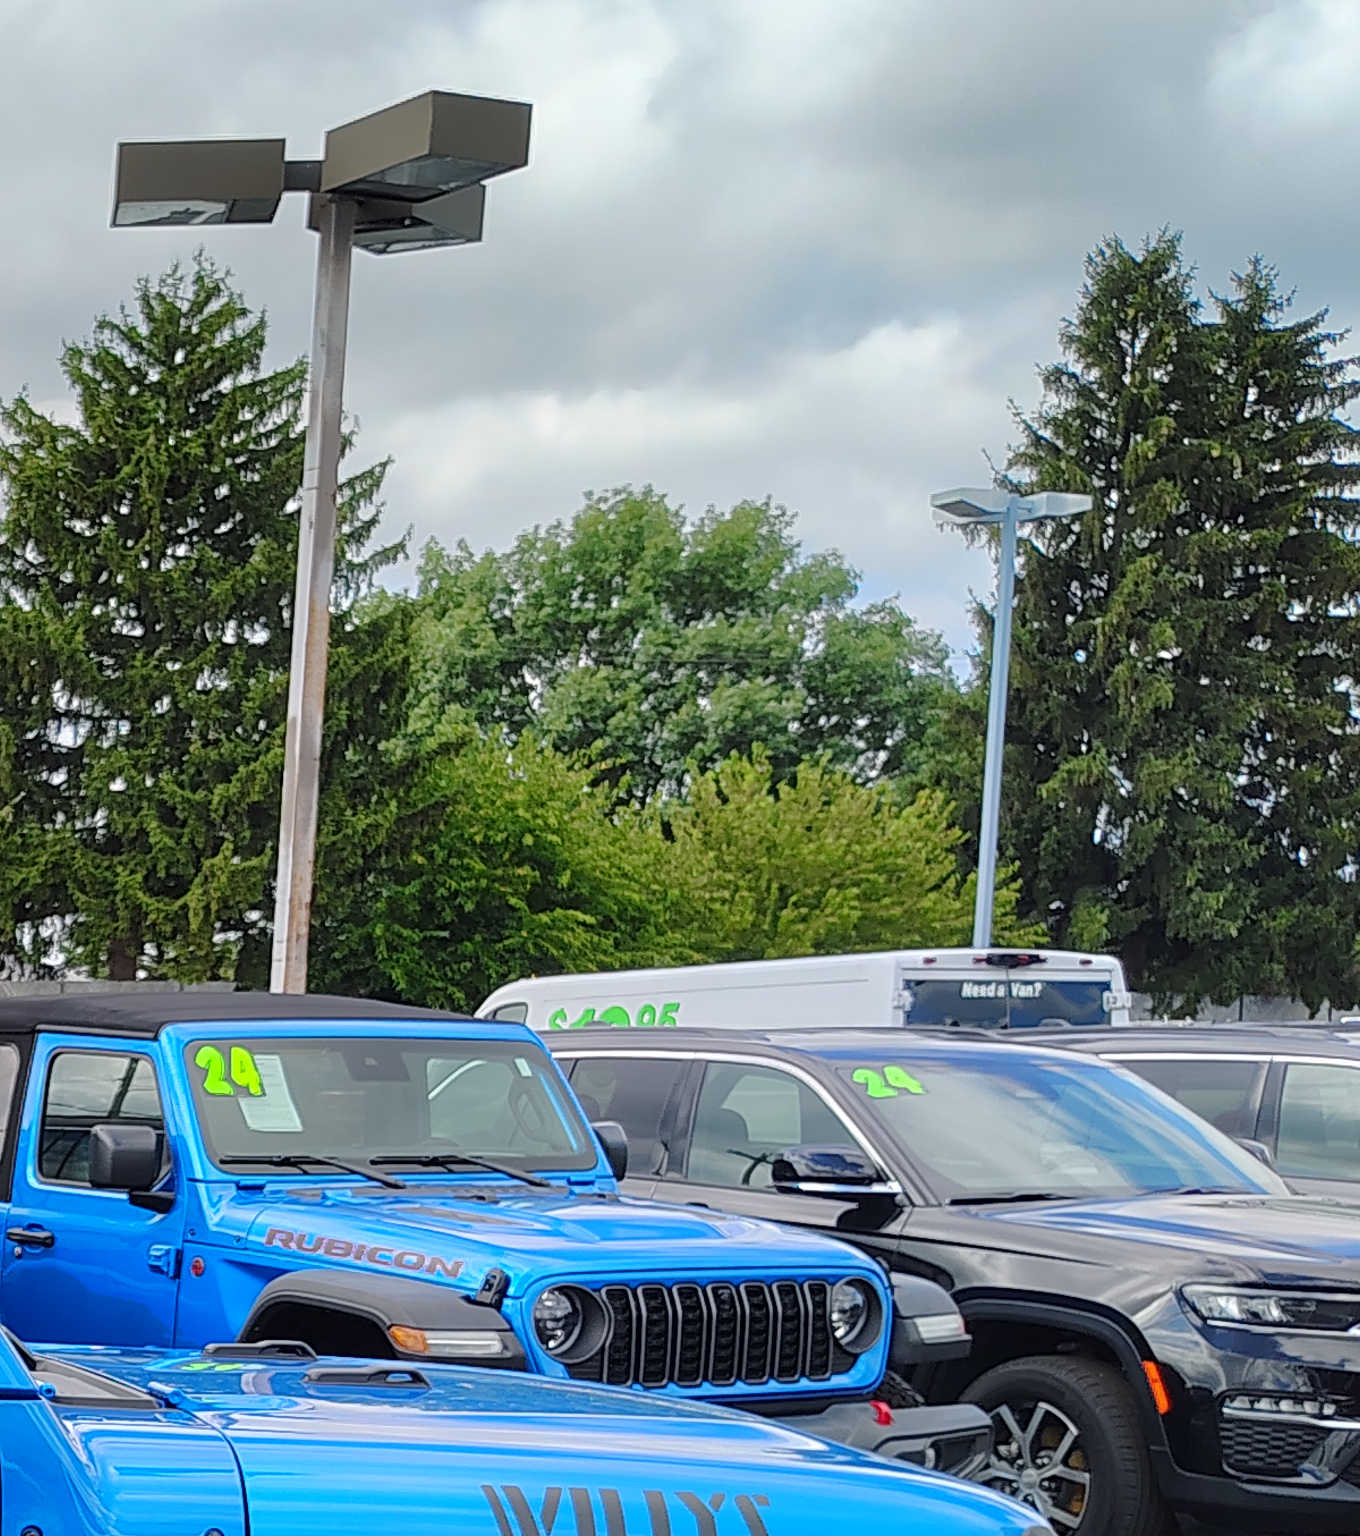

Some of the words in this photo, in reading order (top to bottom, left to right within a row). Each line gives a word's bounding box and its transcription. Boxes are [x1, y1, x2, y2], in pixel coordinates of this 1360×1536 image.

[961, 982, 996, 998] Need
[996, 984, 1005, 998] a
[1011, 982, 1047, 998] Van?
[195, 1045, 264, 1096] 24
[852, 1064, 926, 1098] 24
[264, 1228, 465, 1278] RUBICON
